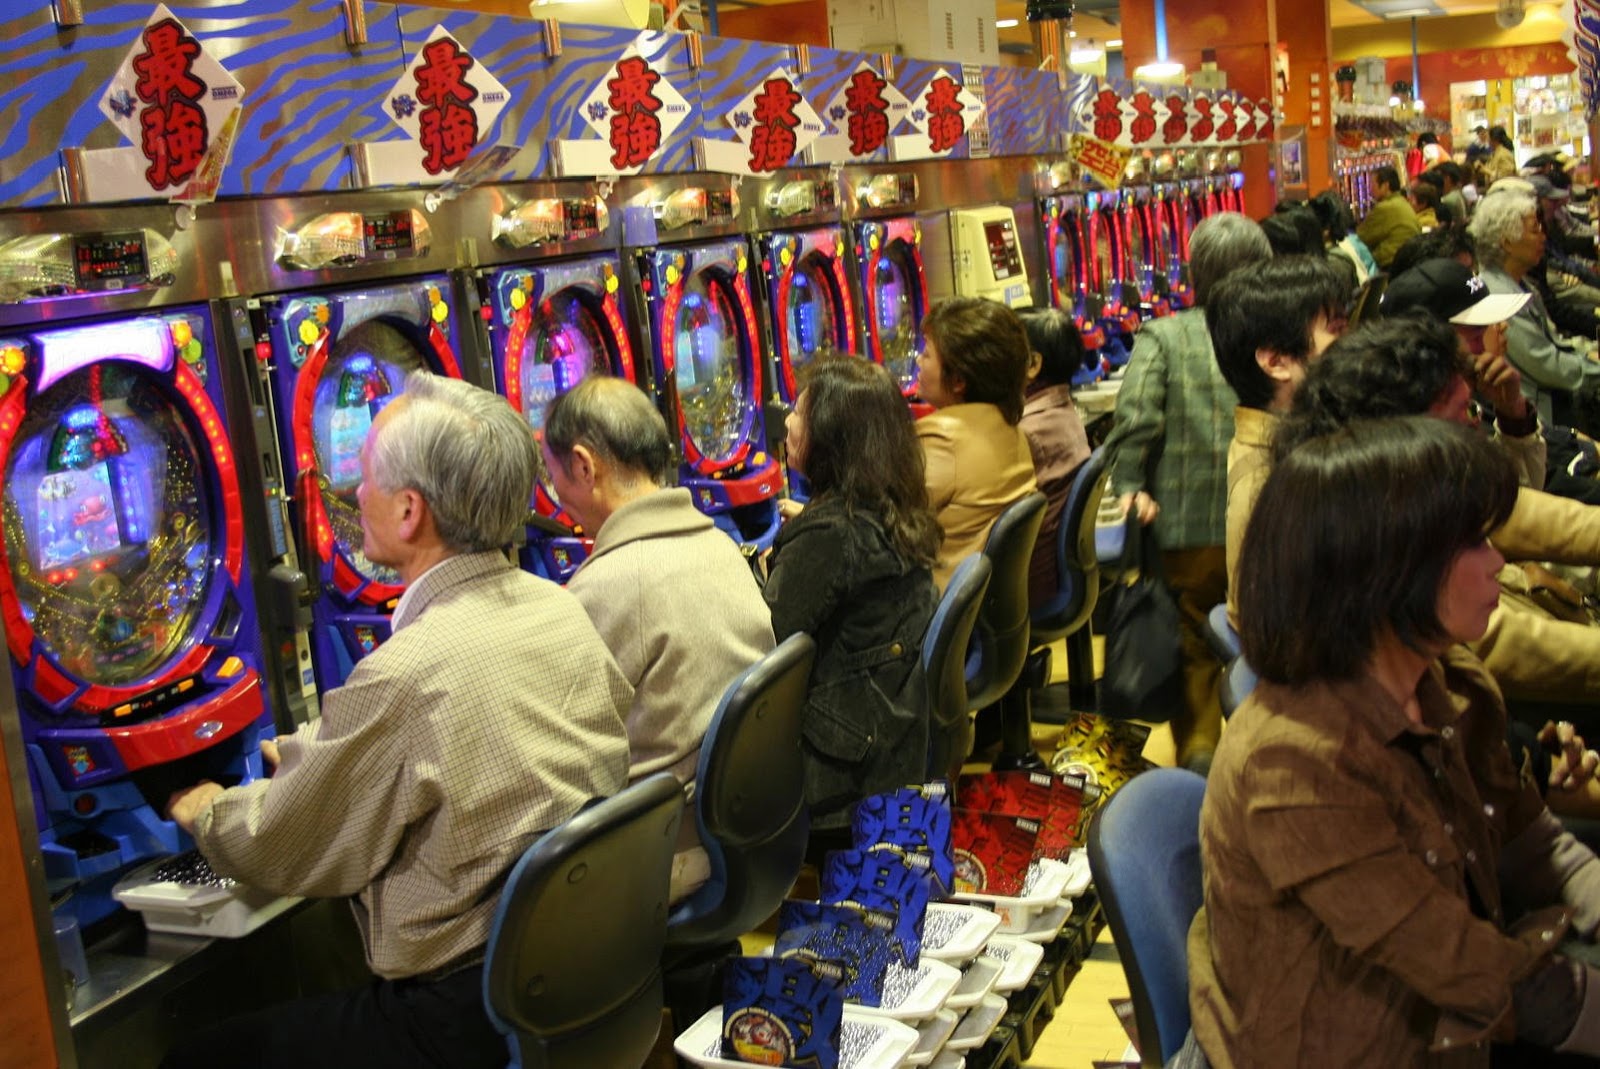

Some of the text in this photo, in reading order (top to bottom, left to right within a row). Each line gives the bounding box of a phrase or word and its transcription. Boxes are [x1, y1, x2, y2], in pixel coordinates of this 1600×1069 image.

[133, 17, 207, 191] 最強
[410, 37, 479, 175] 最強
[607, 56, 663, 171] 最強
[749, 78, 802, 172] 最強
[846, 69, 890, 156] 最強
[925, 76, 964, 153] 最強
